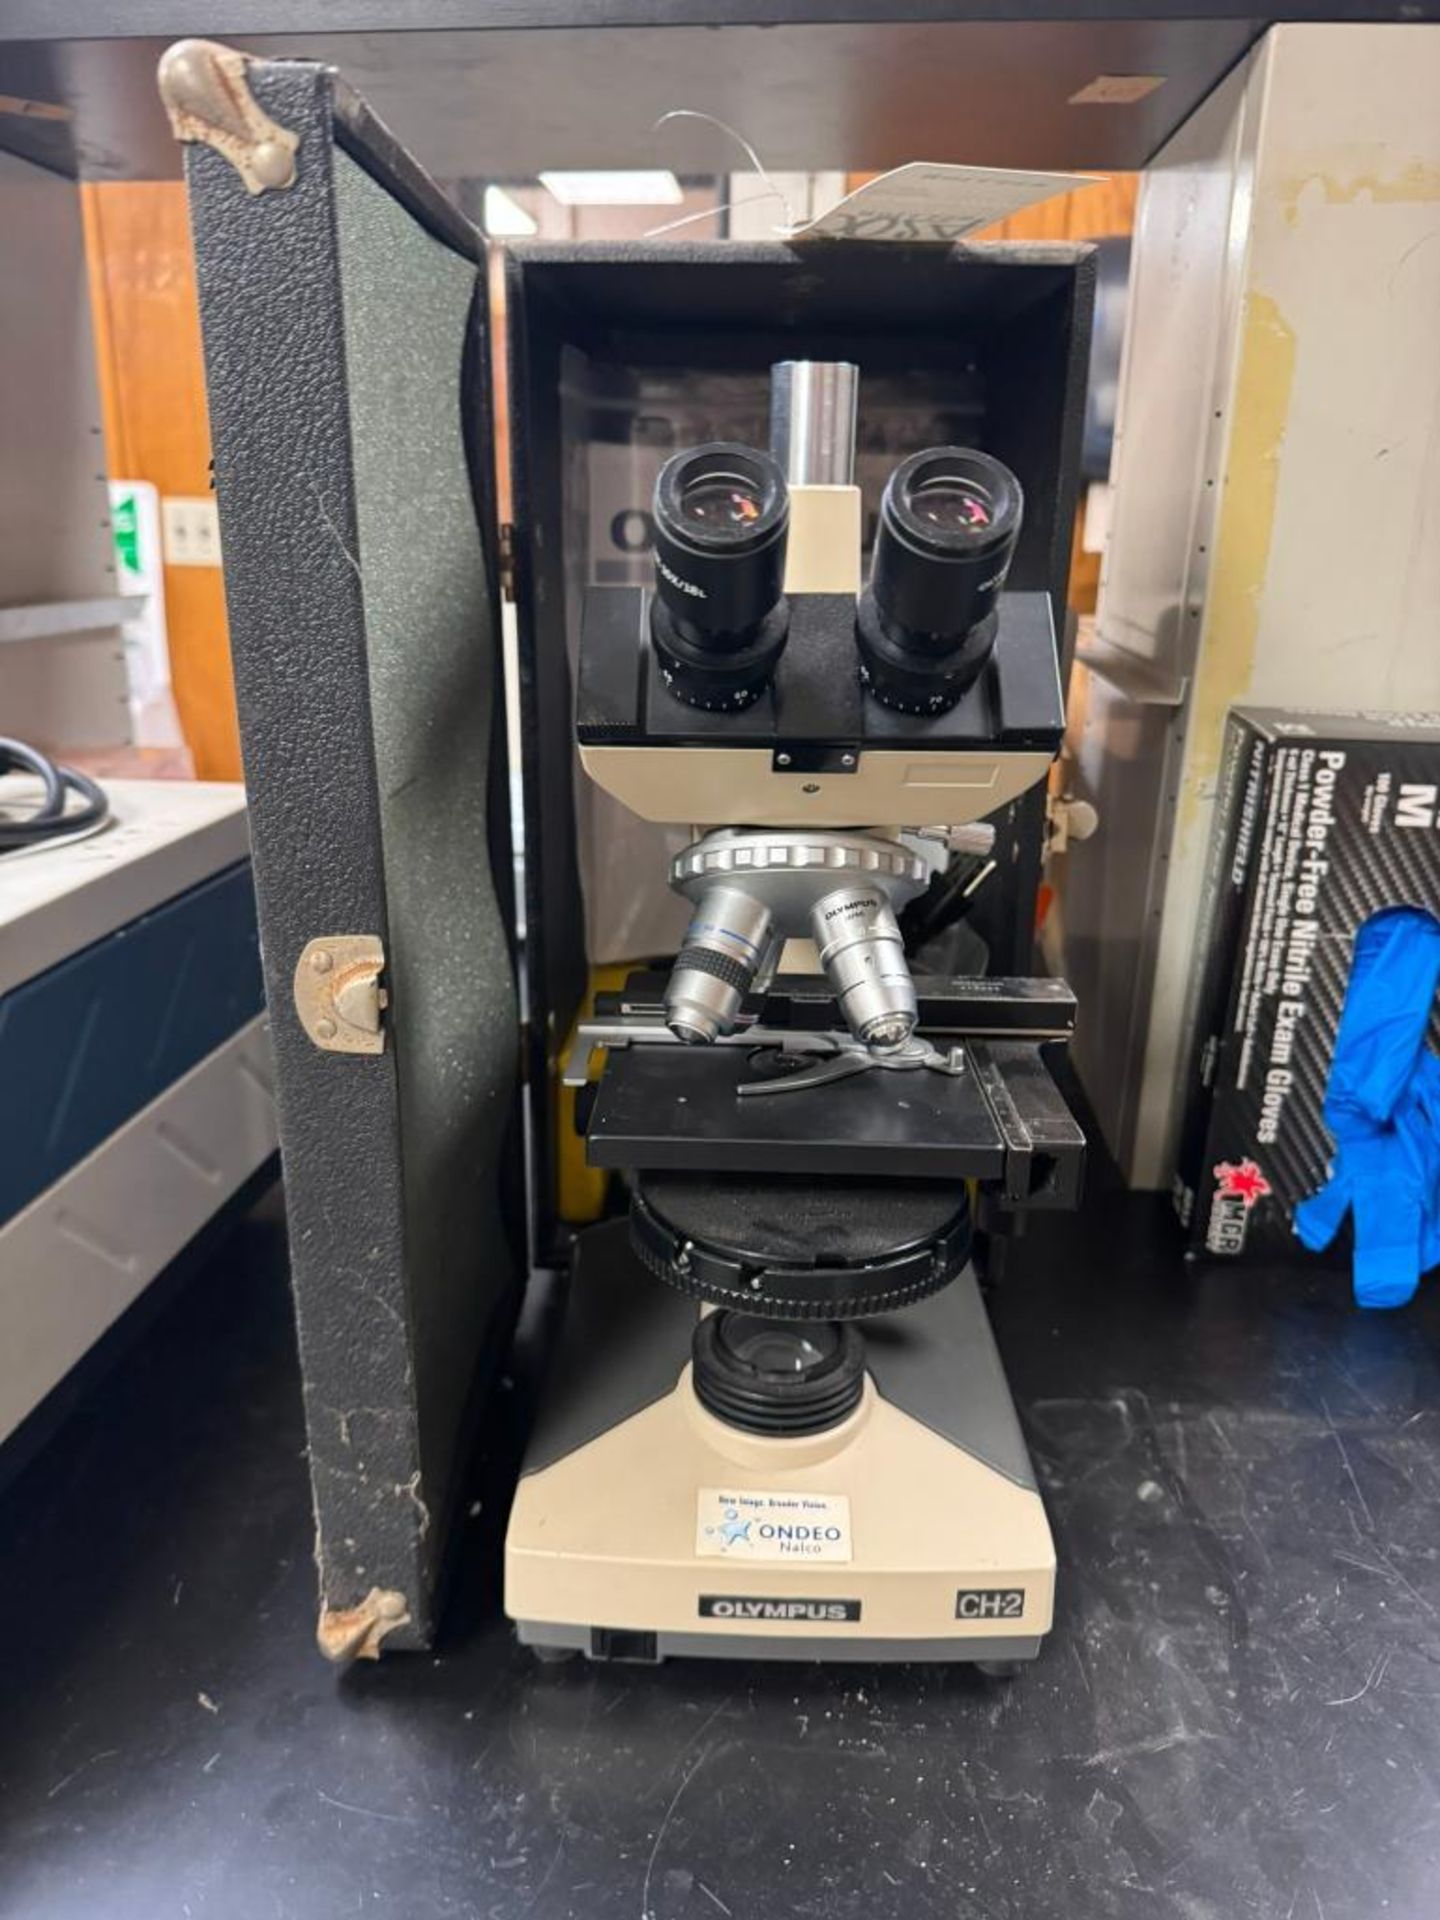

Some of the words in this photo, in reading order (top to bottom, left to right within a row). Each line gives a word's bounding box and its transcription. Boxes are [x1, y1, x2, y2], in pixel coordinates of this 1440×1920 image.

[1299, 748, 1315, 781] Class
[1231, 739, 1266, 885] NITRISHIELD
[1290, 792, 1309, 838] Medical
[1394, 784, 1437, 828] M
[1293, 748, 1346, 915] Powder-Free
[824, 898, 878, 921] OLYMPUS
[1277, 881, 1294, 915] Single
[1275, 917, 1289, 938] Use
[1270, 940, 1284, 968] Exam
[1281, 918, 1318, 997] Nitrile
[1265, 970, 1279, 994] Only
[1269, 999, 1304, 1065] Exam
[1256, 1068, 1293, 1144] Gloves
[1218, 1202, 1245, 1251] MCR
[759, 1524, 842, 1541] ONDEO
[780, 1541, 822, 1554] Nalco
[711, 1600, 848, 1620] OLYMPUS
